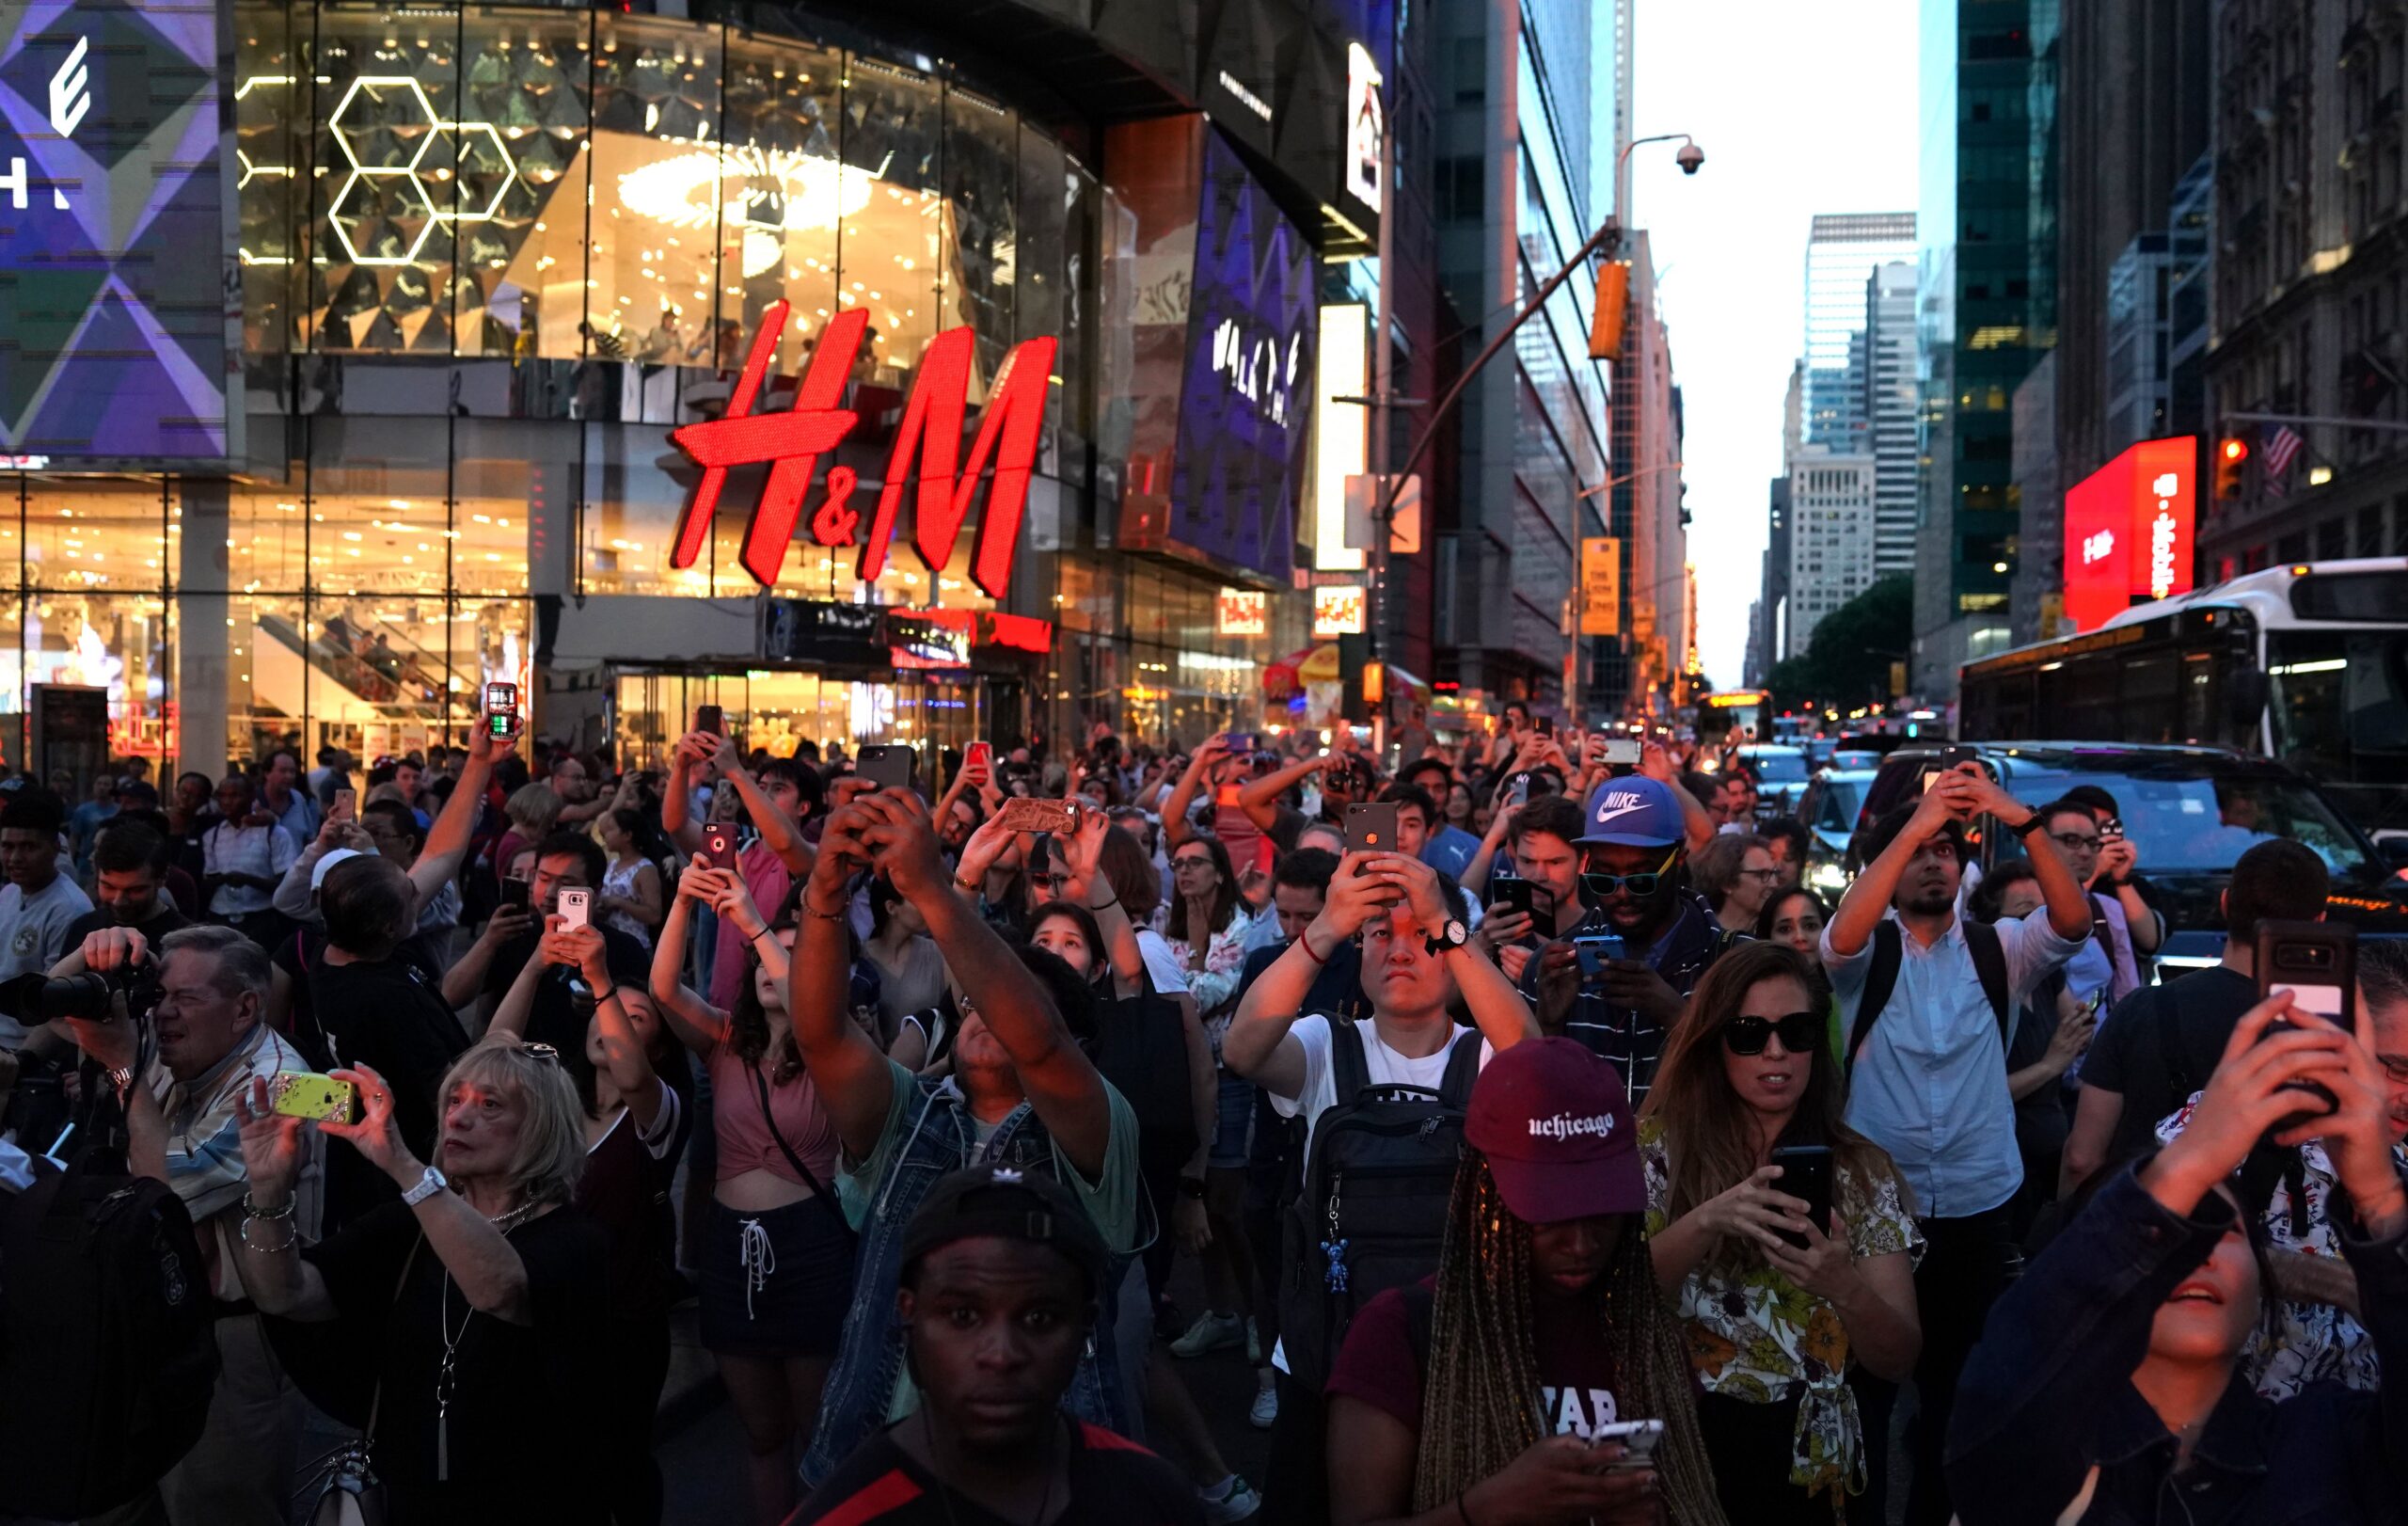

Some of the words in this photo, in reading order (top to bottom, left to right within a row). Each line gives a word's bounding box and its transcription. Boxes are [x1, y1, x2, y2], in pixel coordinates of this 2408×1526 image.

[666, 298, 1058, 599] H&M
[1604, 791, 1641, 809] NIKE
[1528, 1111, 1614, 1142] uchicago
